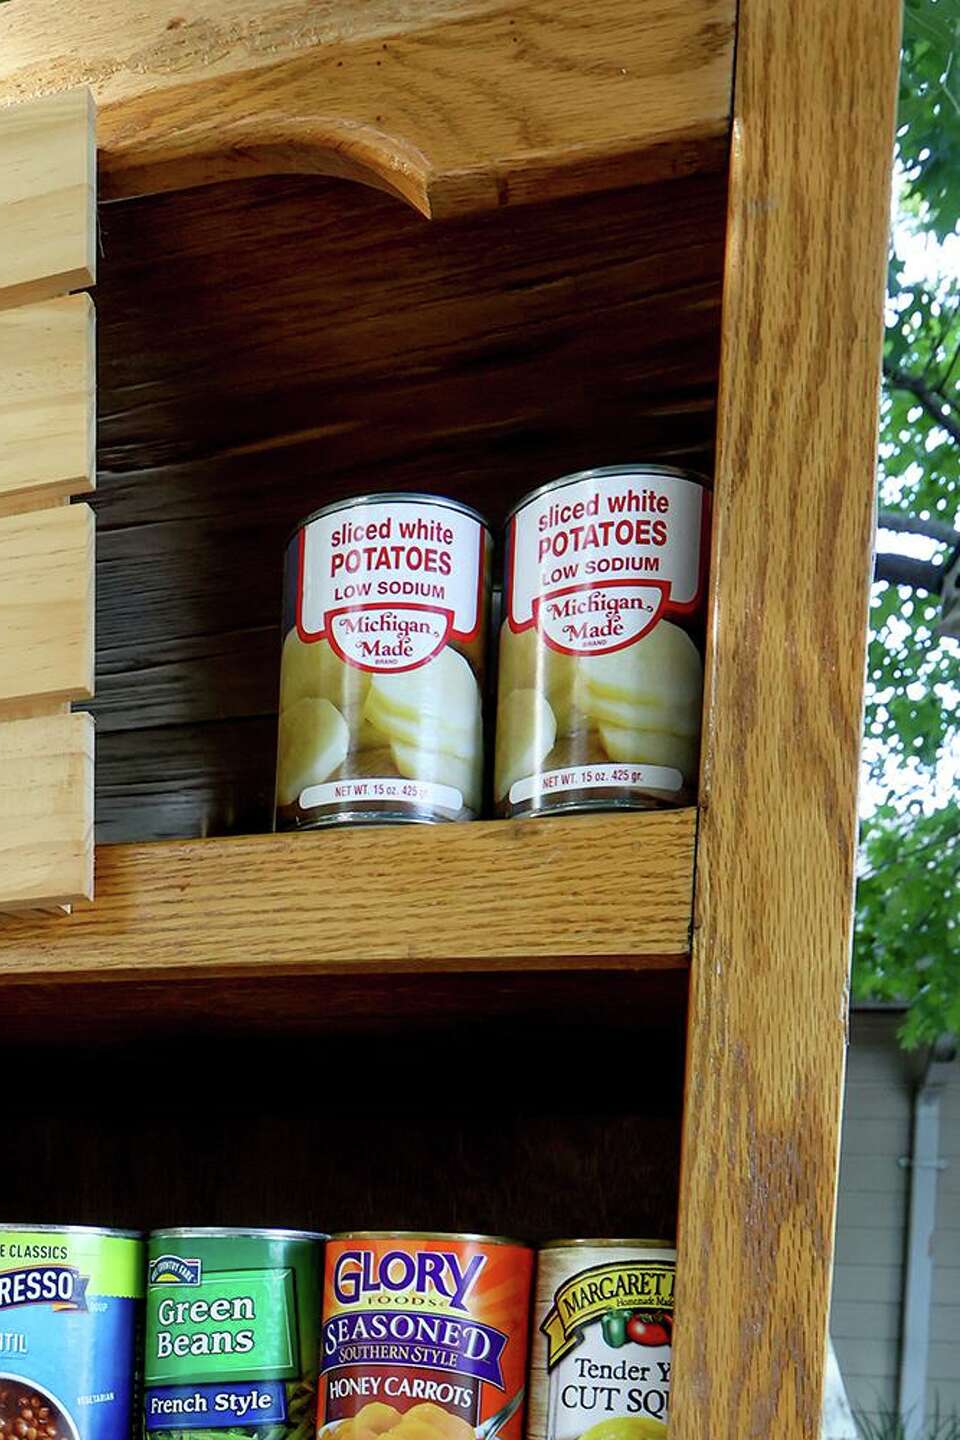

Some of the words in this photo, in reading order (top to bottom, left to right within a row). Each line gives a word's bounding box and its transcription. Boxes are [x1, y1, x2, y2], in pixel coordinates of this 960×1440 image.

[537, 499, 600, 533] sliced
[607, 490, 669, 514] white
[330, 519, 391, 548] sliced
[399, 517, 454, 545] white
[537, 519, 668, 565] POTATOES
[330, 545, 453, 578] POTATOES
[541, 562, 579, 587] LOW
[585, 556, 660, 575] SODIUM
[334, 583, 371, 601] LOW
[377, 581, 446, 600] SODIUM
[546, 592, 654, 622] Michigan
[339, 611, 440, 638] Michigan
[562, 616, 624, 641] Made
[355, 636, 414, 659] Made
[334, 786, 352, 797] NET
[374, 784, 385, 795] 15
[402, 786, 419, 797] 425
[542, 777, 558, 789] NET
[581, 772, 592, 783] 15
[611, 771, 628, 781] 425
[9, 1244, 68, 1260] CLASSICS
[334, 1250, 488, 1313] GLORY
[368, 1295, 438, 1307] FOODS
[562, 1272, 665, 1319] MARGARET
[158, 1297, 256, 1326] Green
[157, 1330, 254, 1358] Beans
[325, 1314, 491, 1360] SEASONED
[339, 1345, 410, 1363] SOUTHERN
[410, 1346, 458, 1368] STYLE
[575, 1357, 651, 1381] Tender
[151, 1393, 208, 1414] French
[214, 1391, 272, 1416] Style
[330, 1376, 382, 1400] HONEY
[384, 1376, 474, 1408] CARROTS
[561, 1384, 619, 1410] CUT
